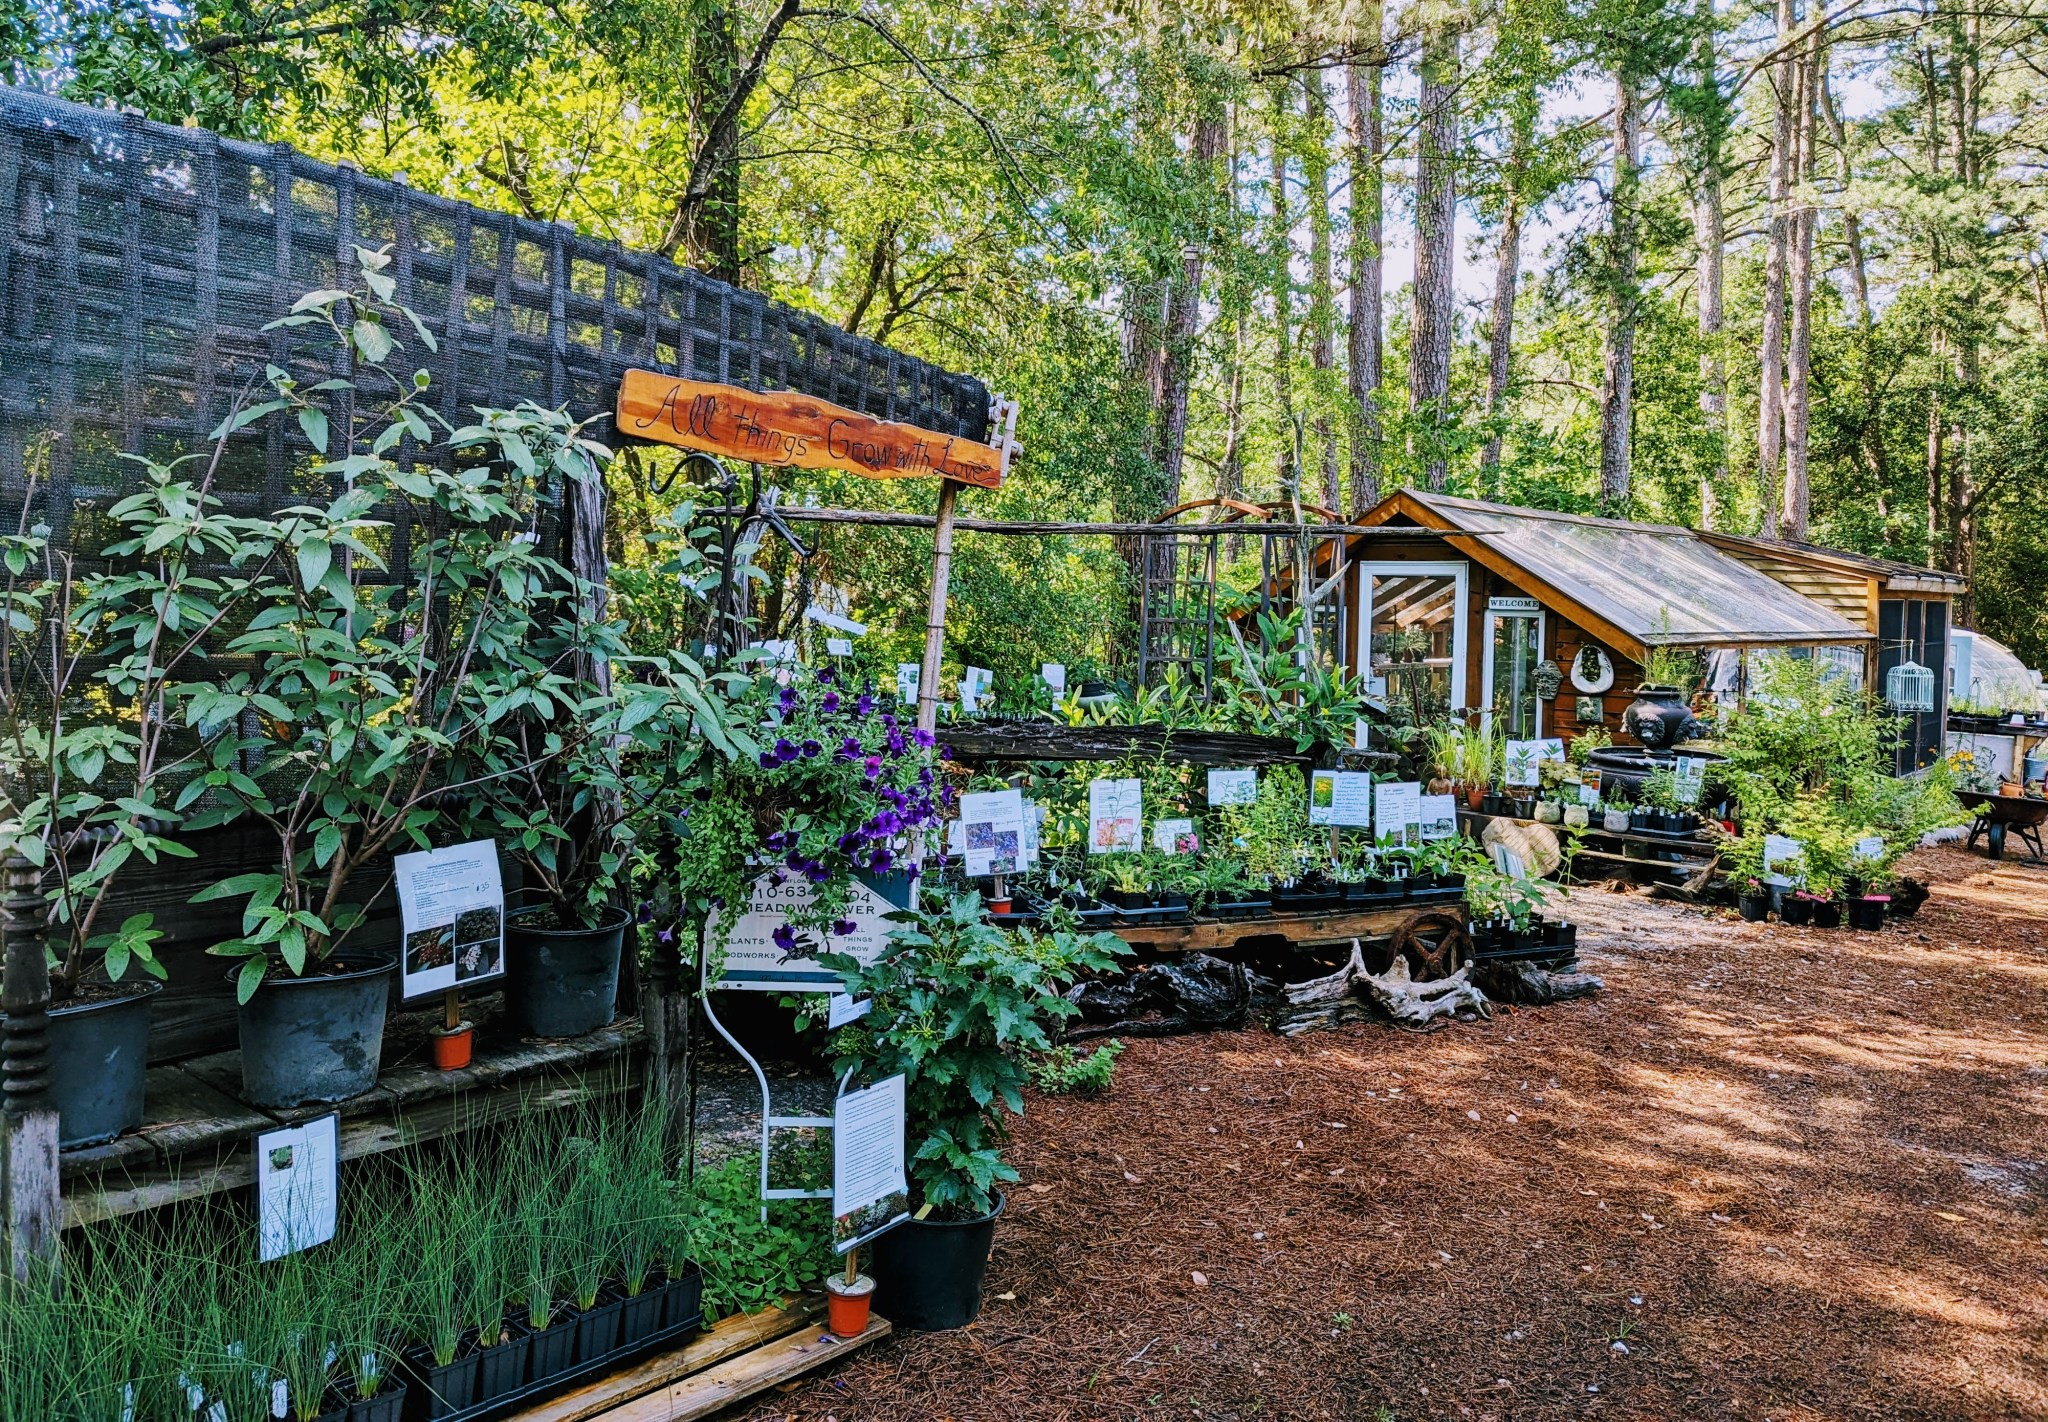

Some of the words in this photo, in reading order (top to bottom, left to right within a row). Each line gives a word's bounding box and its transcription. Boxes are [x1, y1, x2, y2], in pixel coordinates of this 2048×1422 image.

[635, 384, 719, 442] All
[828, 418, 893, 466] Grow
[895, 438, 931, 473] with
[932, 438, 998, 482] Love
[1490, 600, 1539, 608] WELCOME
